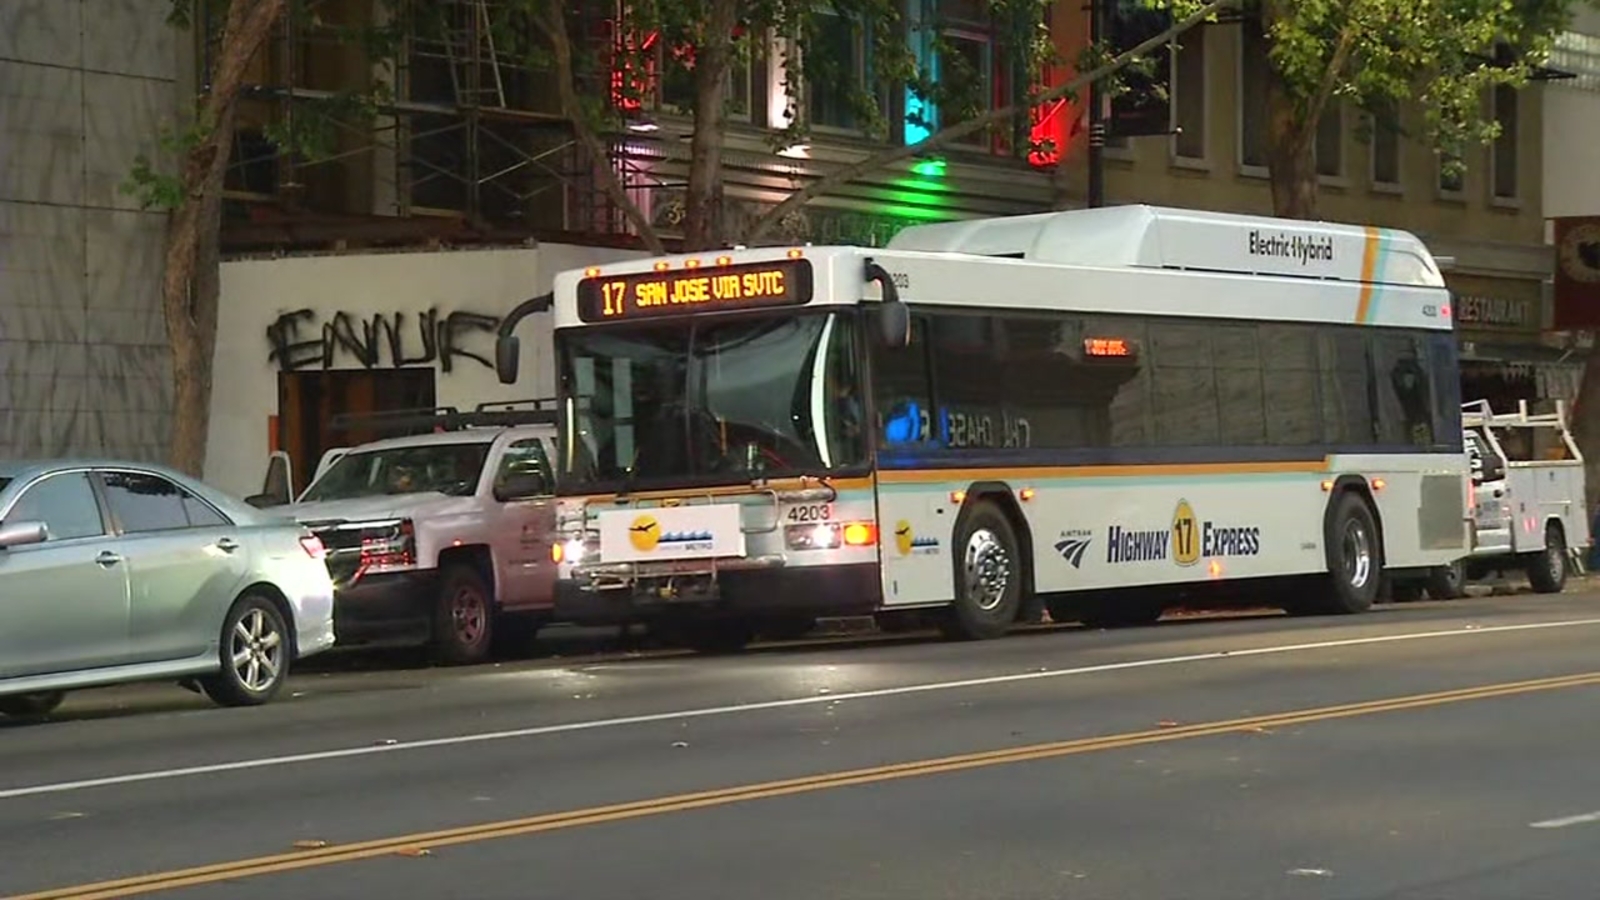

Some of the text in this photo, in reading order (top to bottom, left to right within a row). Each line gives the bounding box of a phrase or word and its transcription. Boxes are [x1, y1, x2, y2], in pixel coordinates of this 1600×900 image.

[601, 270, 785, 315] 17 SAN JOSE VIA SVTC
[893, 273, 909, 288] 203
[787, 504, 831, 522] 4203
[1106, 518, 1260, 564] HIGHWAY 17 EXPRESS
